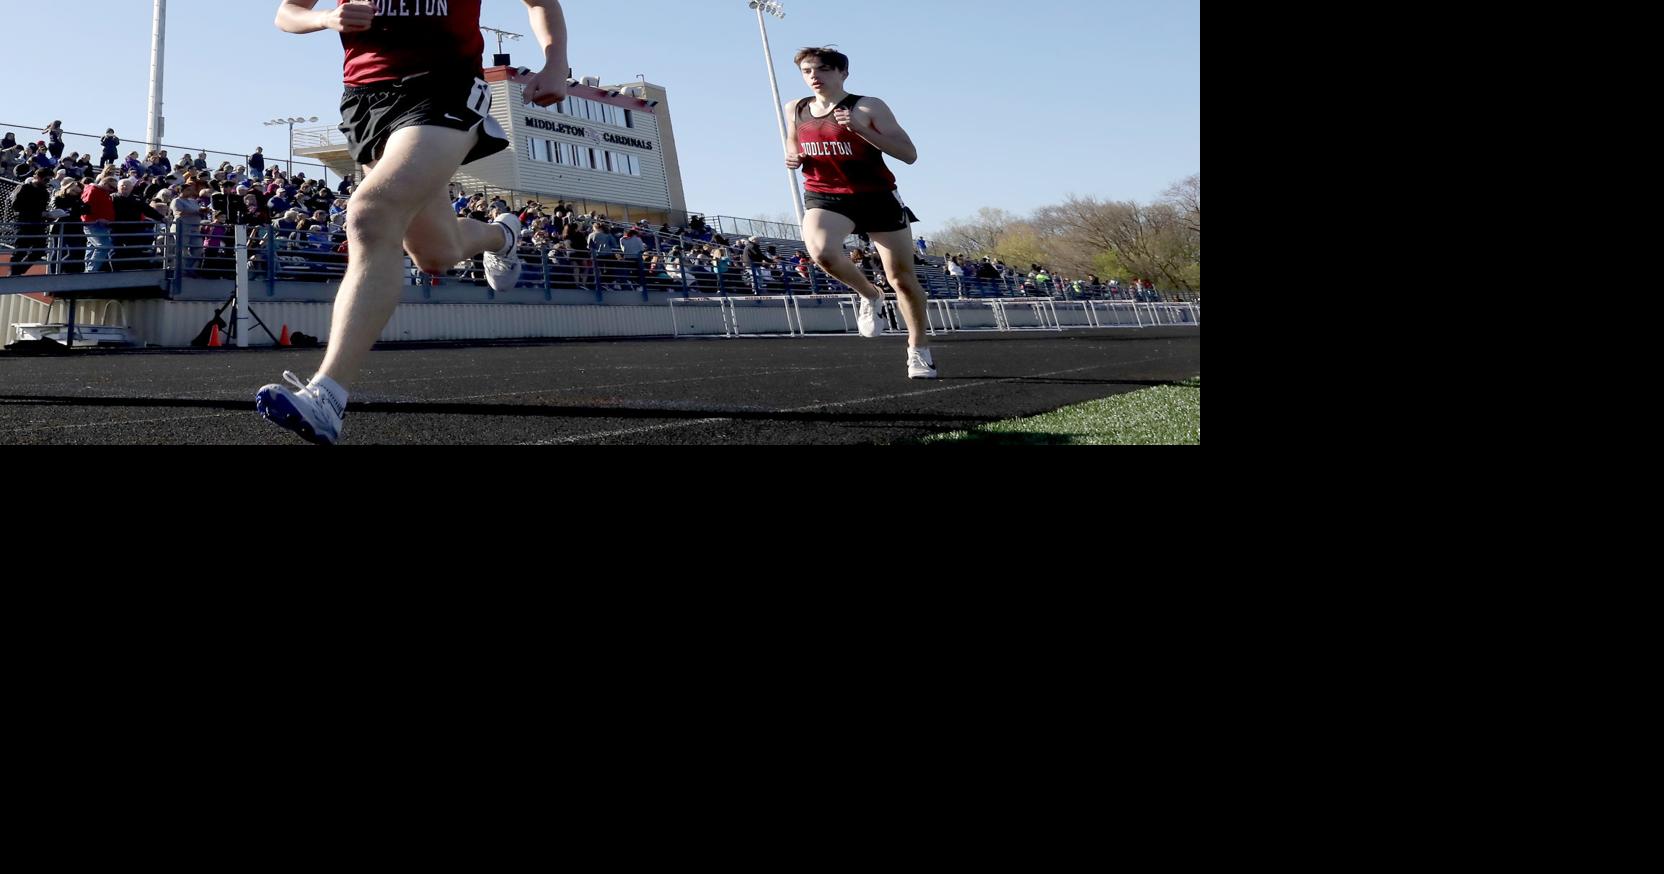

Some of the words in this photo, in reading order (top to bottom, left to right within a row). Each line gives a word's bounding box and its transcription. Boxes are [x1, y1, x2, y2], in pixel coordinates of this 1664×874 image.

[375, 0, 447, 16] DLETON
[525, 116, 585, 137] MIDDLETON
[603, 132, 652, 150] CARDINALS
